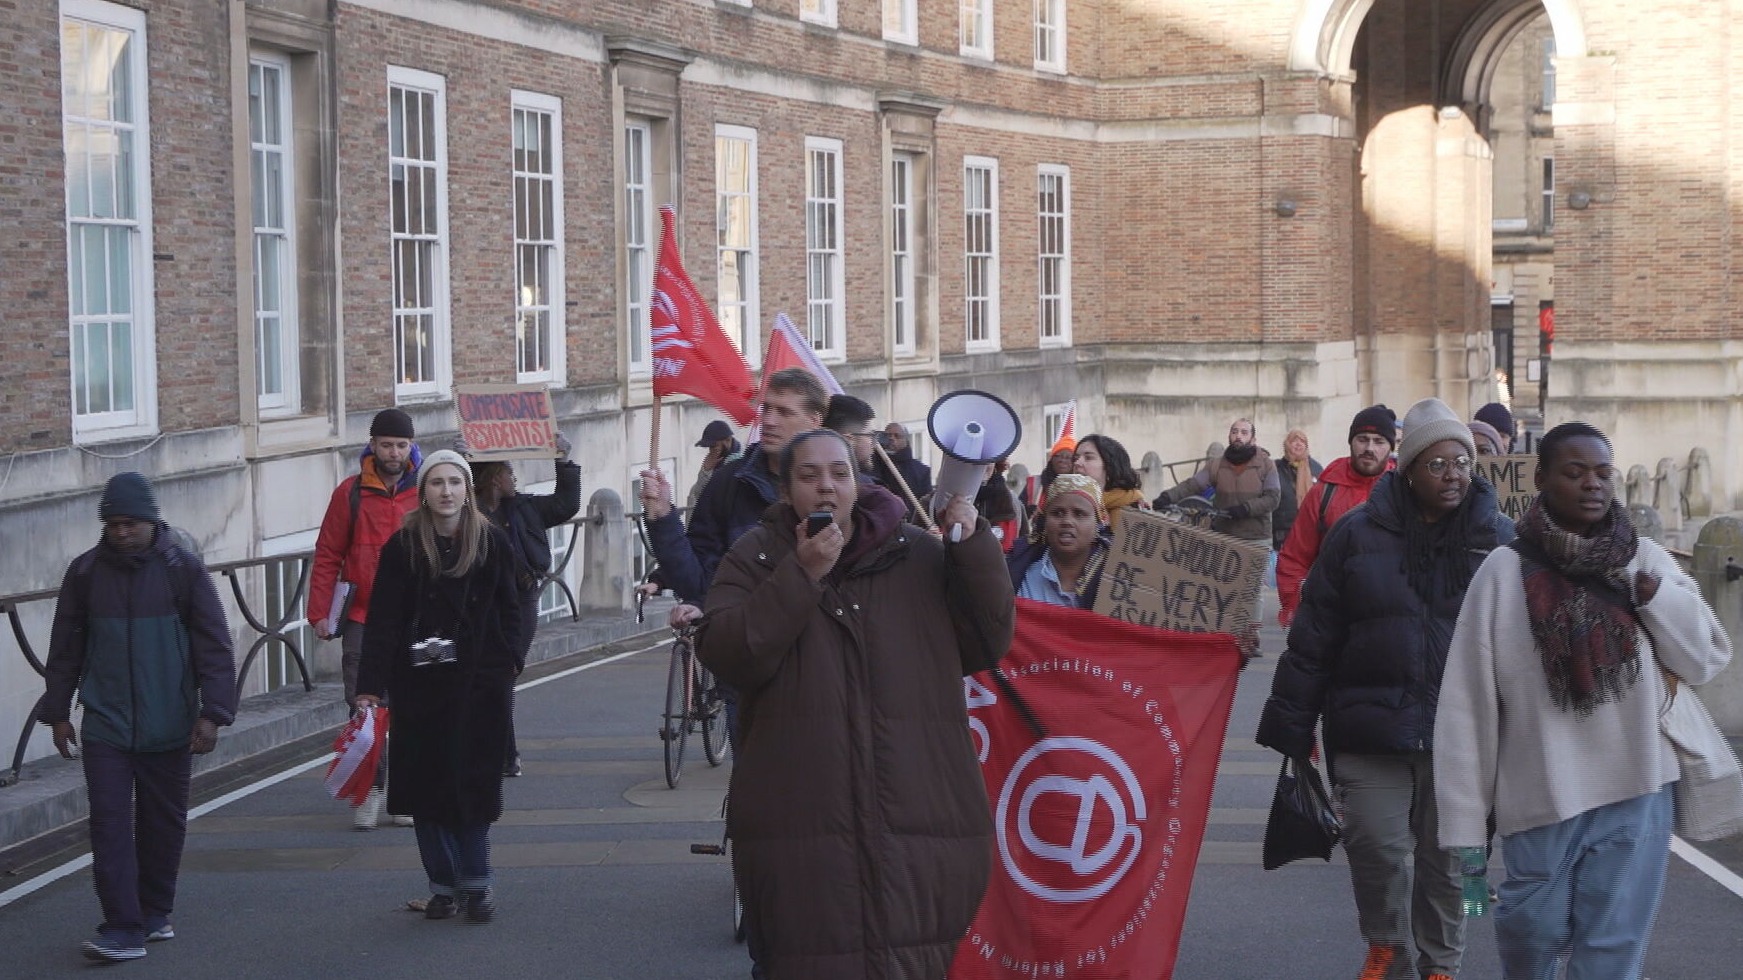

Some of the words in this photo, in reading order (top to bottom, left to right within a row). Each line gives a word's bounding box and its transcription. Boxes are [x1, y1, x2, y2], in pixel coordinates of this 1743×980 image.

[1120, 516, 1163, 559] YOU
[1161, 525, 1243, 586] SHOULD
[1109, 560, 1146, 607] BE
[1161, 575, 1239, 631] VERY
[1121, 680, 1145, 699] of
[965, 925, 996, 961] No
[1076, 945, 1107, 969] for
[1000, 953, 1066, 980] Reform
